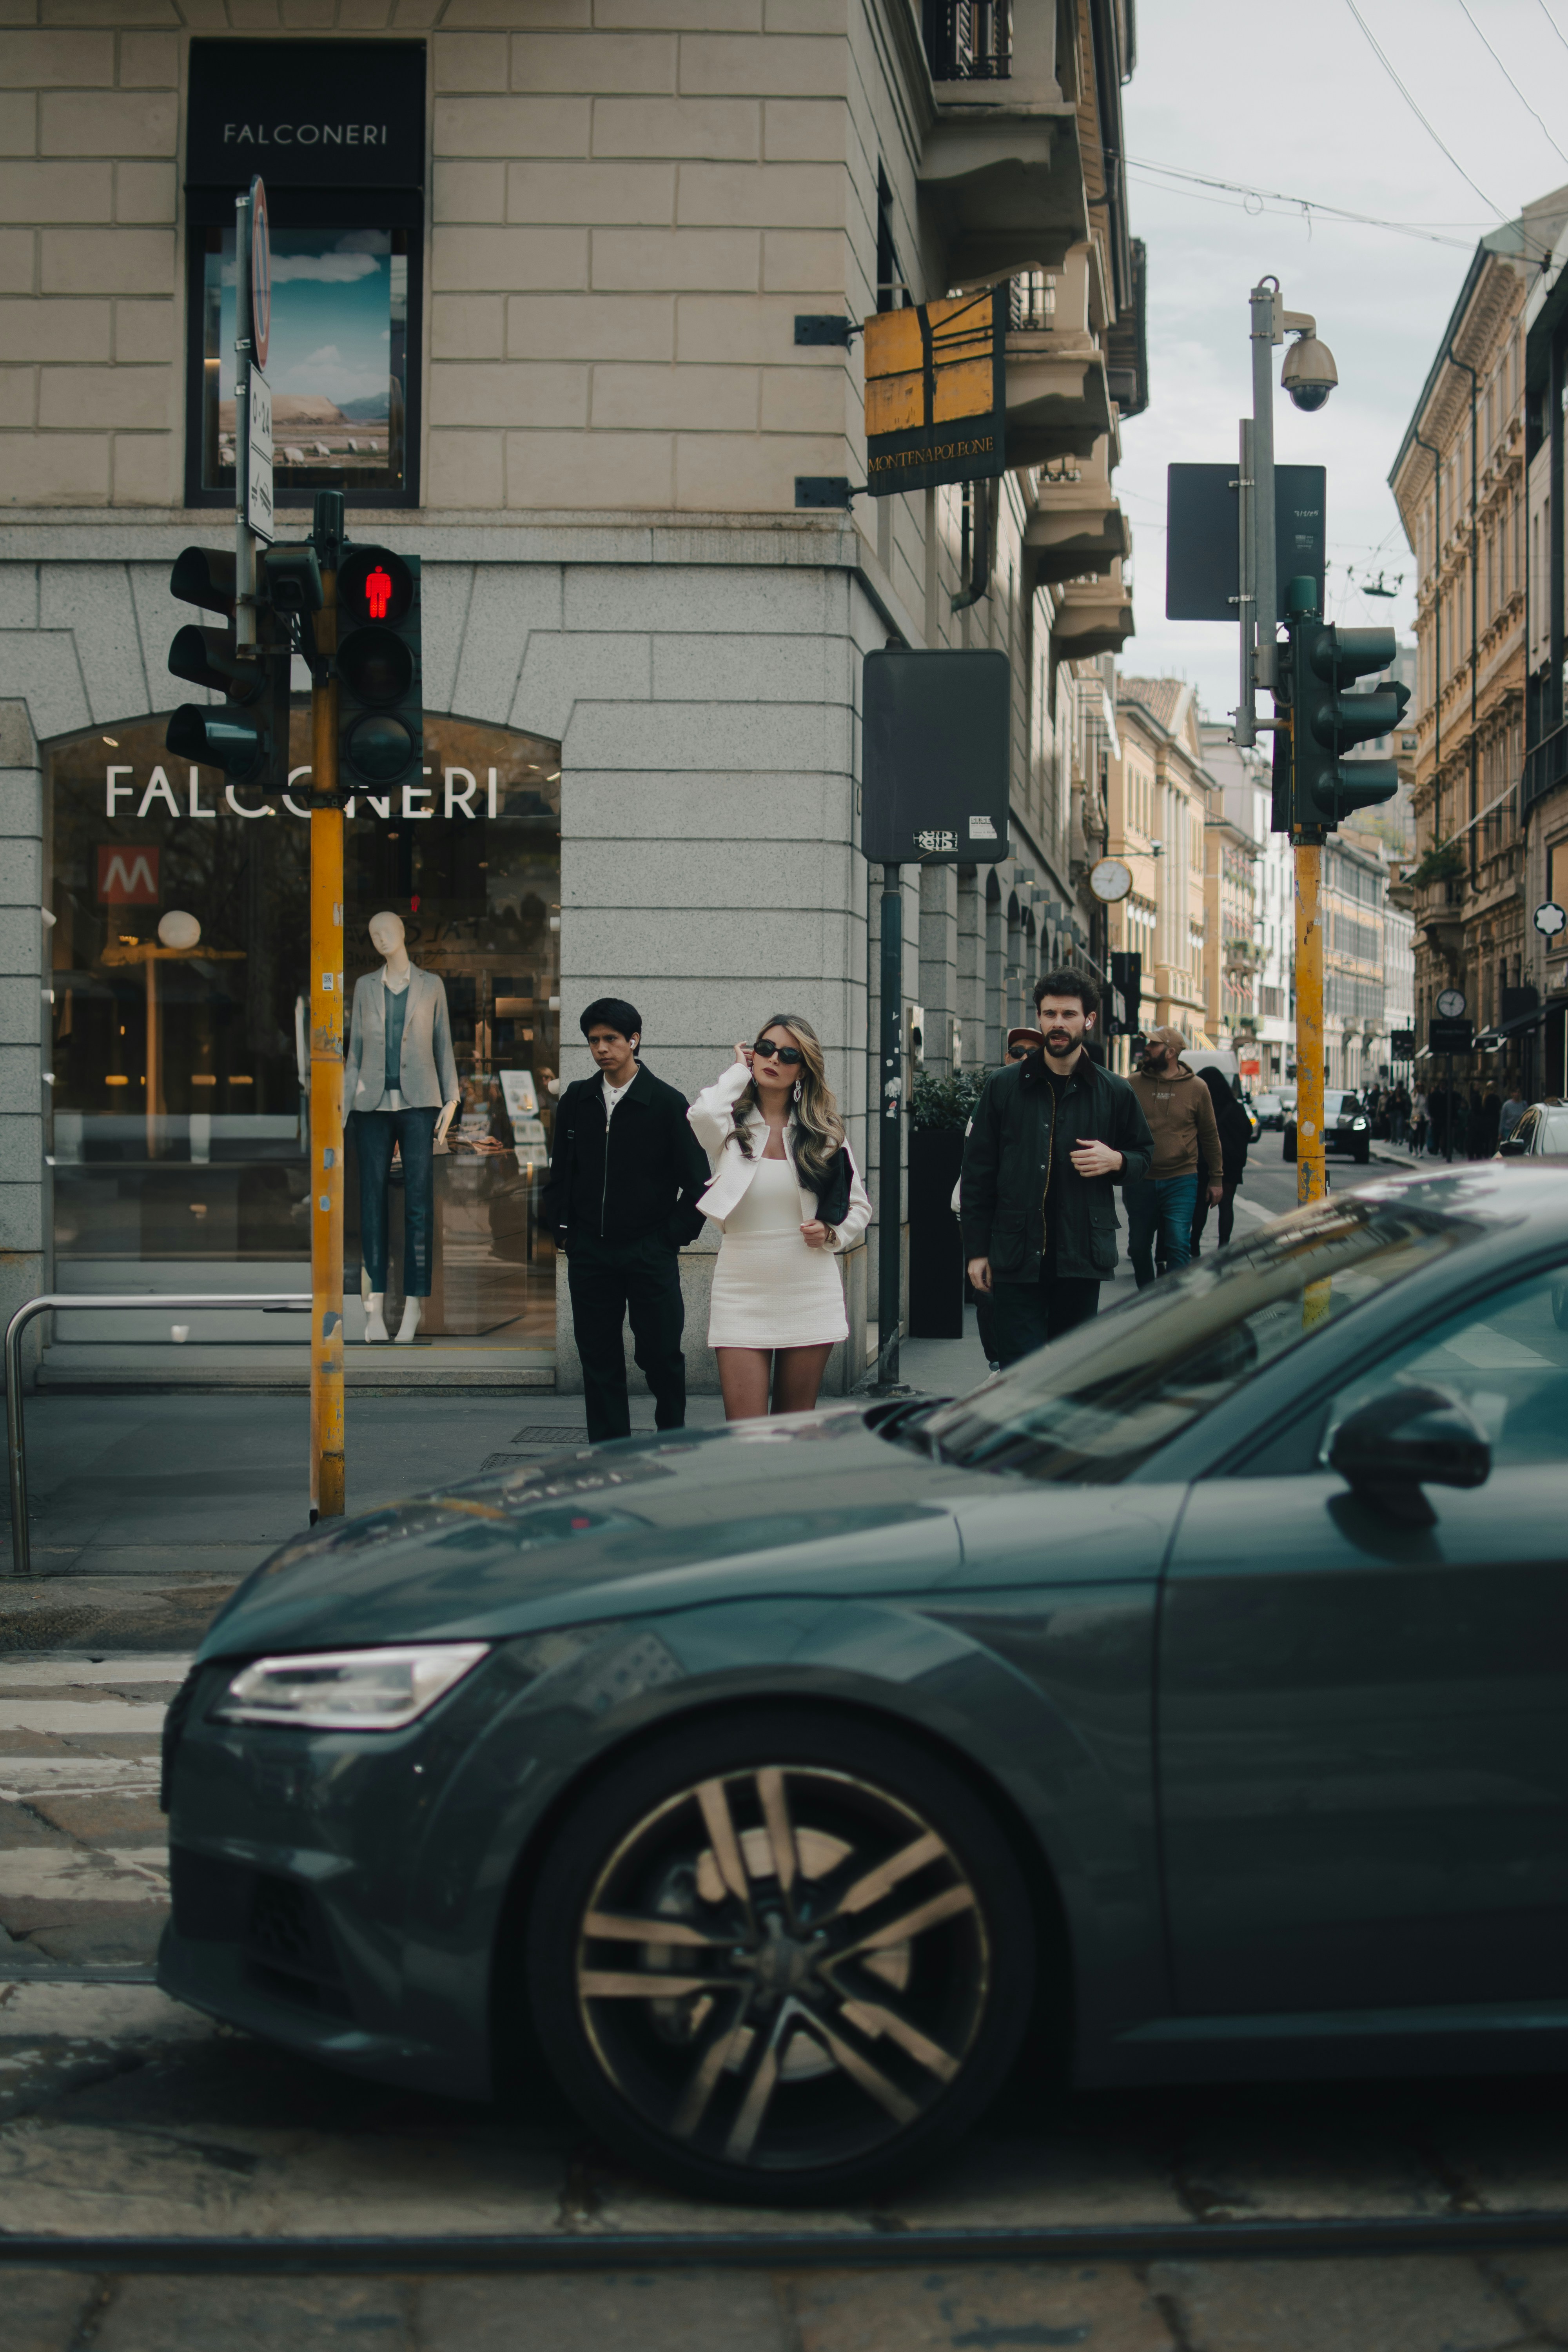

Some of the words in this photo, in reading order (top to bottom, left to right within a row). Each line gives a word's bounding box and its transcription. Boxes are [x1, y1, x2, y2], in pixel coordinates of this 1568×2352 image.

[224, 124, 387, 144] FALCONERI
[868, 436, 993, 472] MONTENAPOLEONE
[103, 855, 156, 893] M
